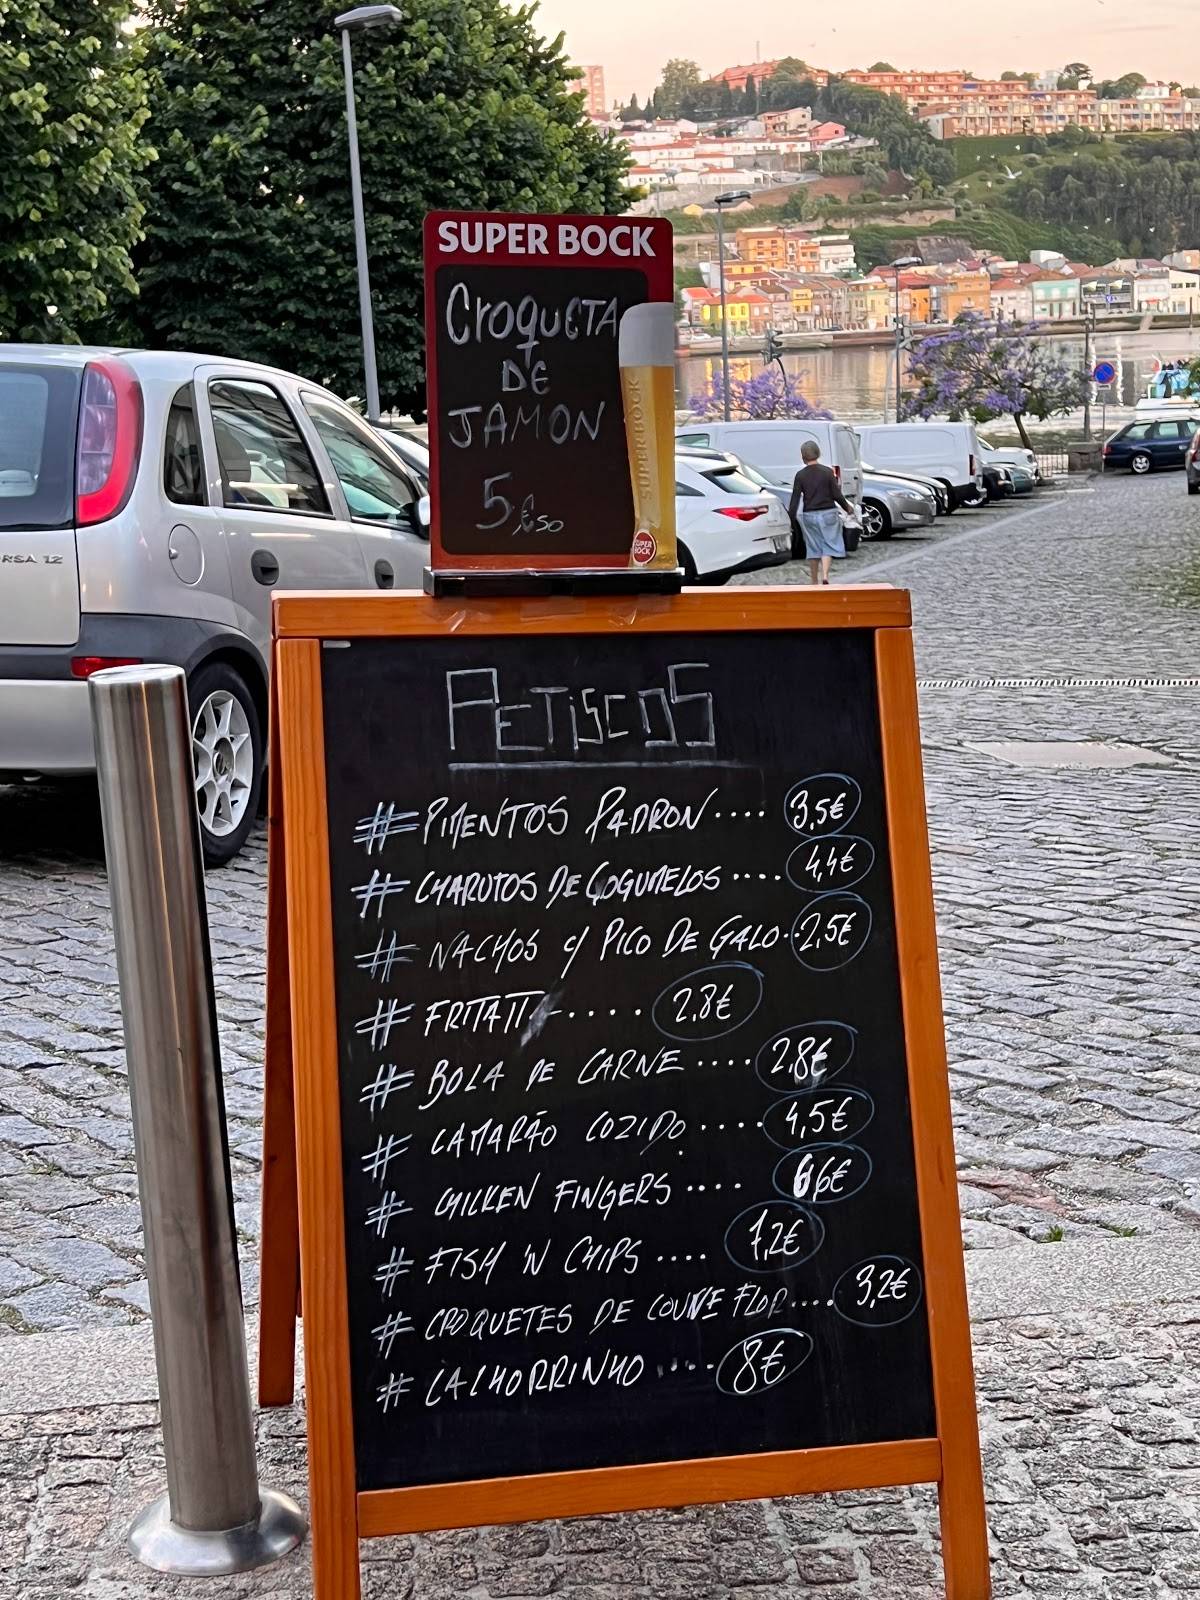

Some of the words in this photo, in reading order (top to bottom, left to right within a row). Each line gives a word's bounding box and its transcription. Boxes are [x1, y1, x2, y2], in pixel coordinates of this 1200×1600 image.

[438, 220, 549, 255] SUPER
[558, 223, 656, 257] BOCK
[502, 359, 550, 395] DE
[447, 402, 606, 449] JAMON
[0, 554, 38, 564] RSA
[423, 796, 568, 849] PIMENTOS
[585, 786, 718, 843] PADRON
[789, 789, 846, 830] 3,5€
[415, 871, 537, 907] CHARUTOS
[546, 865, 582, 910] DE
[804, 843, 857, 882] 4,4€
[428, 928, 540, 974] NACHOS
[600, 918, 650, 960] PICO
[662, 917, 700, 957] DE
[709, 915, 780, 959] GALO
[799, 912, 857, 951] 2,5€
[673, 984, 734, 1022] 2,8€
[418, 1059, 505, 1111] BOLA
[525, 1058, 556, 1092] DE
[577, 1046, 685, 1085] CARNE
[585, 1110, 686, 1156] COZIDO
[785, 1096, 853, 1139] 4,5€
[434, 1172, 541, 1221] CHICKEN
[553, 1172, 672, 1221] FINGERS
[424, 1240, 507, 1285] FISH
[564, 1235, 643, 1275] CHIPS
[425, 1303, 573, 1341] CROQUETES
[589, 1298, 635, 1336] DE
[732, 1282, 788, 1319] FLOR
[424, 1348, 645, 1407] CACHORRINHO
[733, 1339, 786, 1394] 8€
